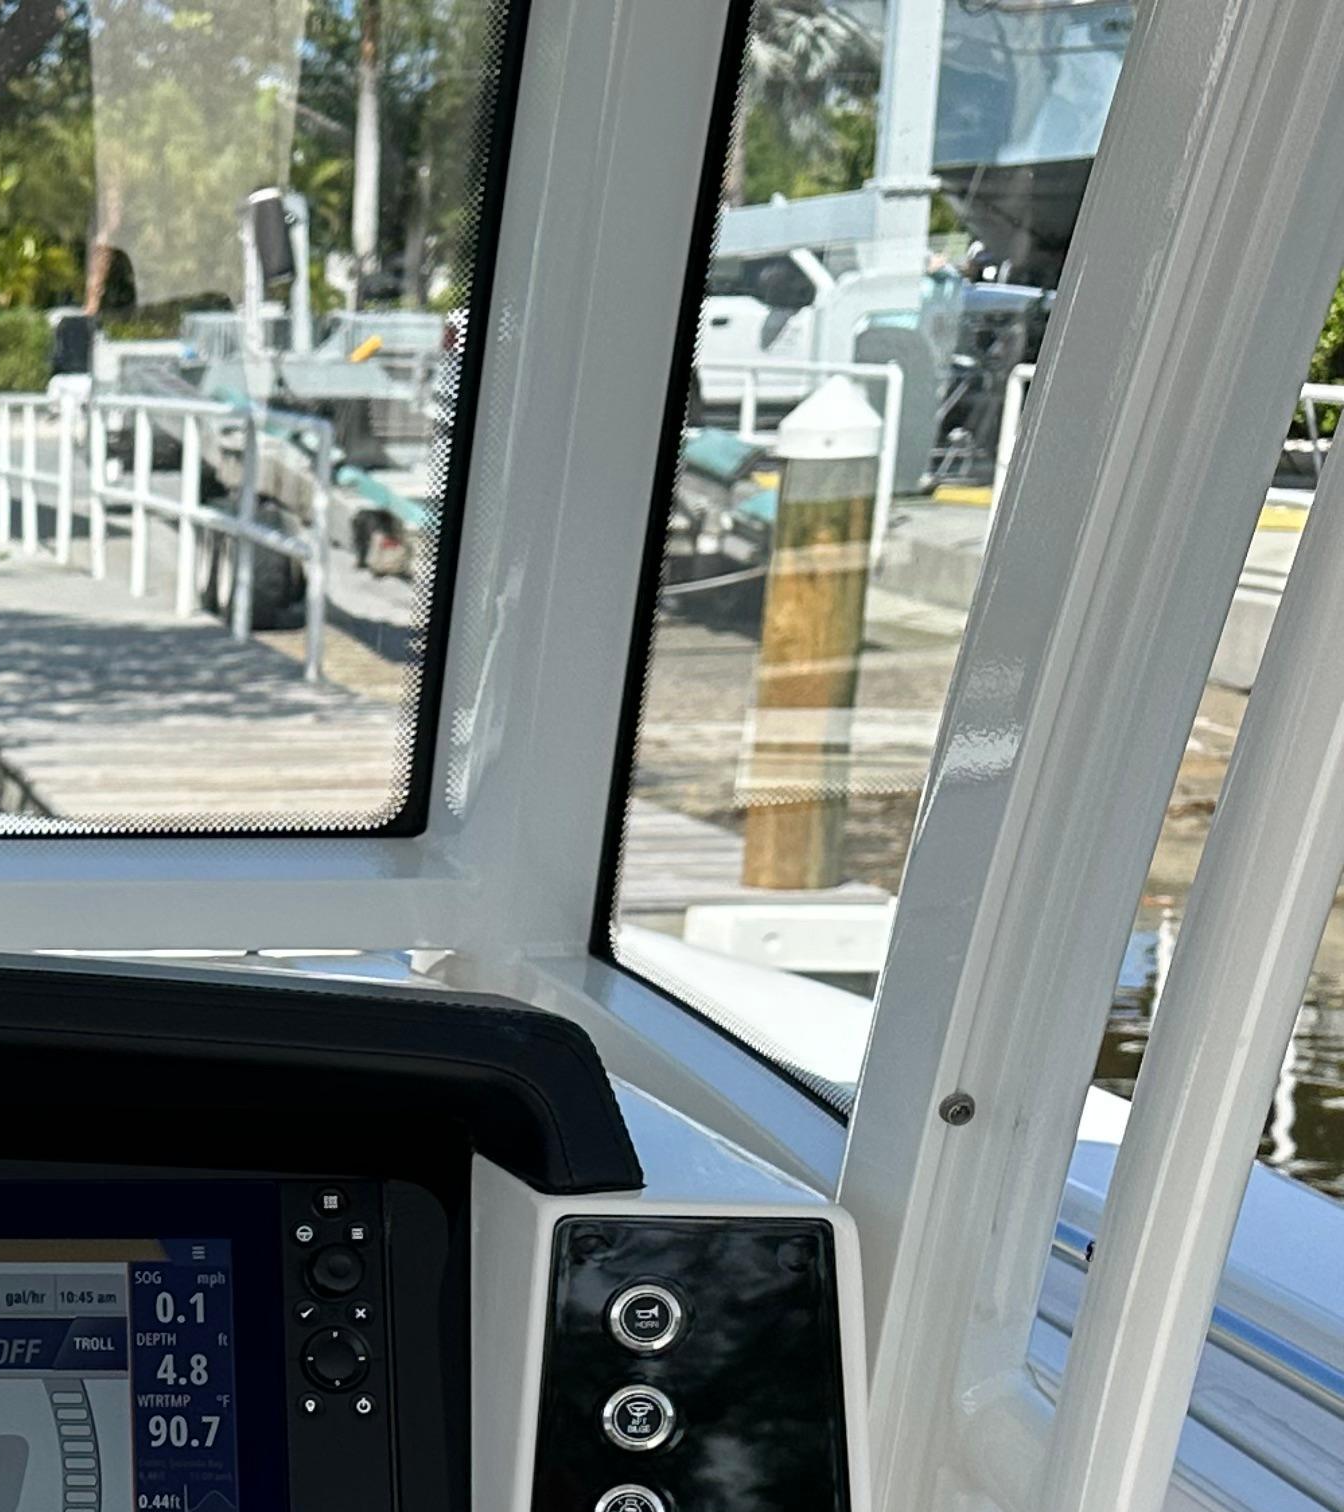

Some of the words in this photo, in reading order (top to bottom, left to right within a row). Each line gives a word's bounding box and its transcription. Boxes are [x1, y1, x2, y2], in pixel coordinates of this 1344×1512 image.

[135, 1270, 162, 1285] SOG
[197, 1271, 226, 1288] mph
[6, 1290, 45, 1306] gal/hr
[59, 1291, 92, 1303] 10:45
[95, 1294, 117, 1303] am
[156, 1292, 205, 1323] 0.1
[74, 1336, 115, 1351] TROLL
[136, 1332, 176, 1347] DEPTH
[218, 1332, 228, 1346] ft
[156, 1354, 208, 1385] 4.8
[137, 1394, 191, 1408] WTRTMP
[148, 1415, 220, 1448] 90.7
[138, 1495, 180, 1510] 0.44ft
